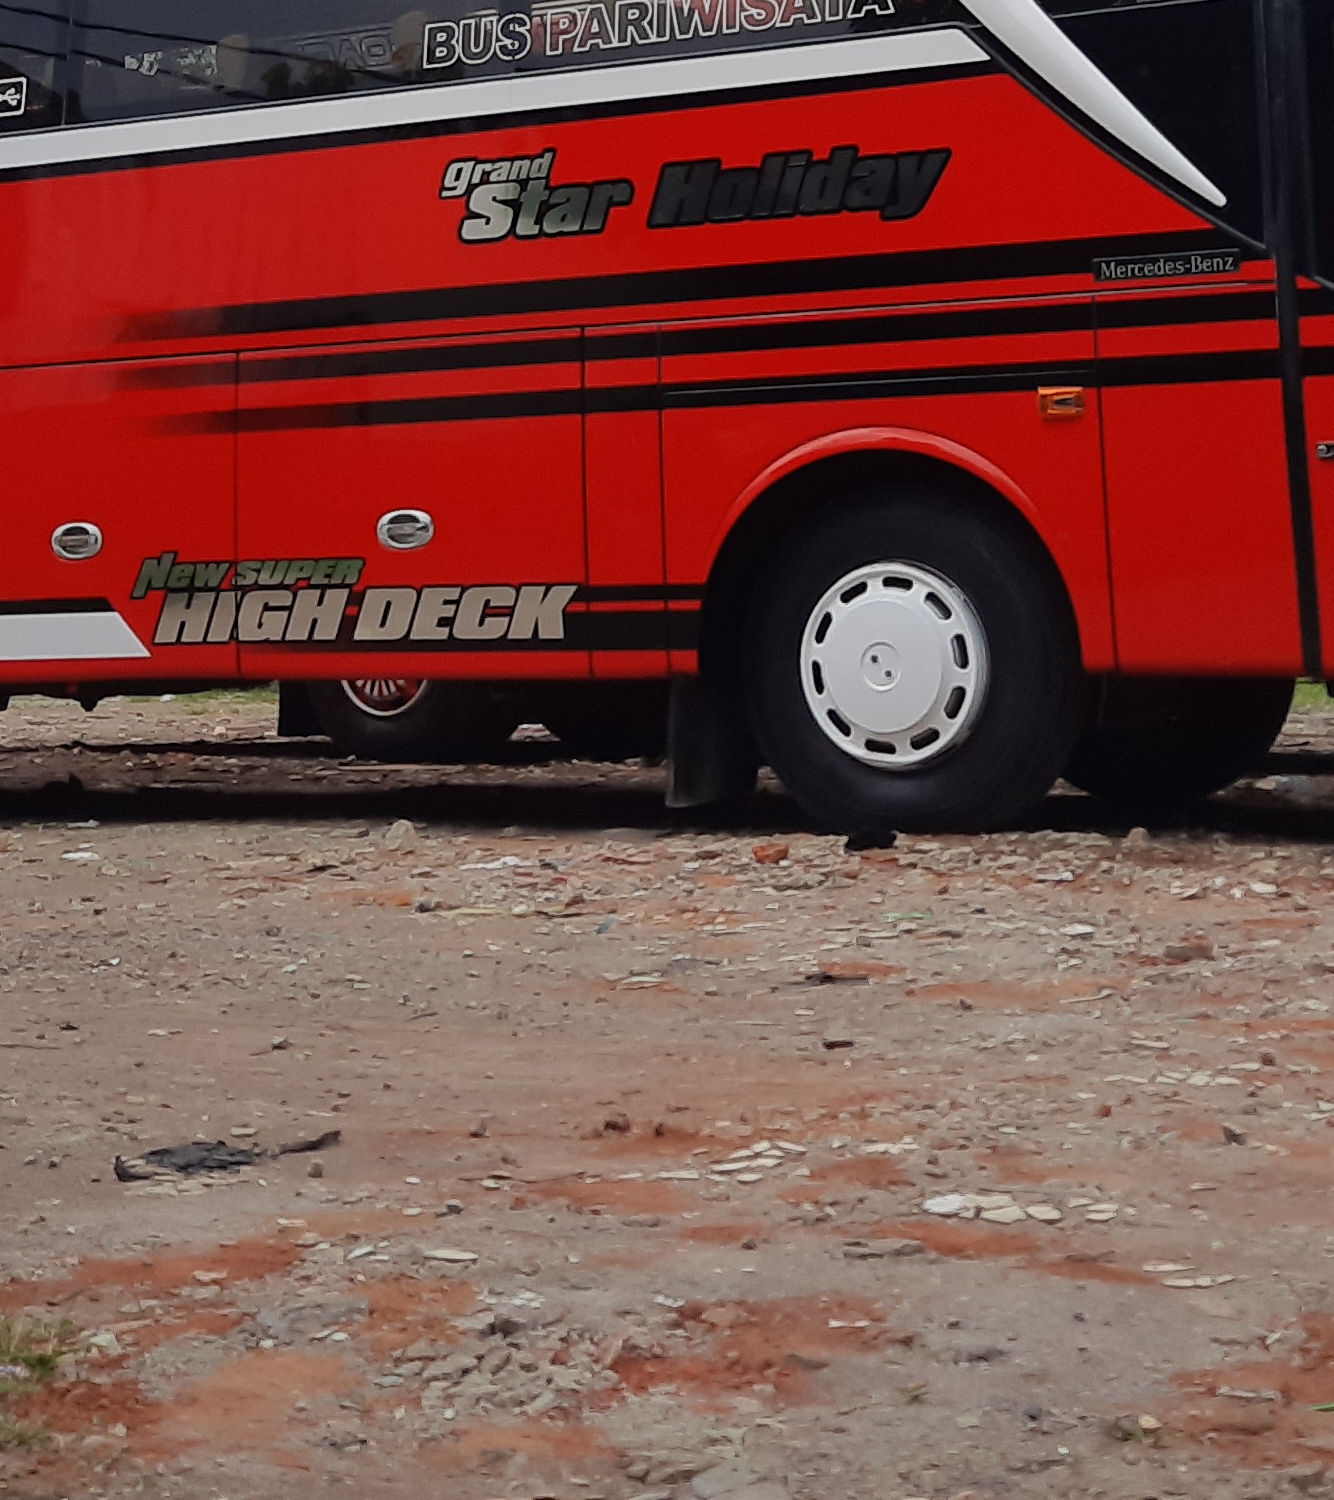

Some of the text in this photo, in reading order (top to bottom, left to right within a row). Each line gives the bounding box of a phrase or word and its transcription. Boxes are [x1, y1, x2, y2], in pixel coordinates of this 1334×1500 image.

[422, 11, 532, 70] BUS
[440, 148, 557, 199] grand
[459, 145, 953, 243] Star Holiday
[1099, 254, 1234, 281] Mercedes-Benz
[232, 557, 366, 588] SUPER
[153, 584, 579, 644] HIGH DECK
